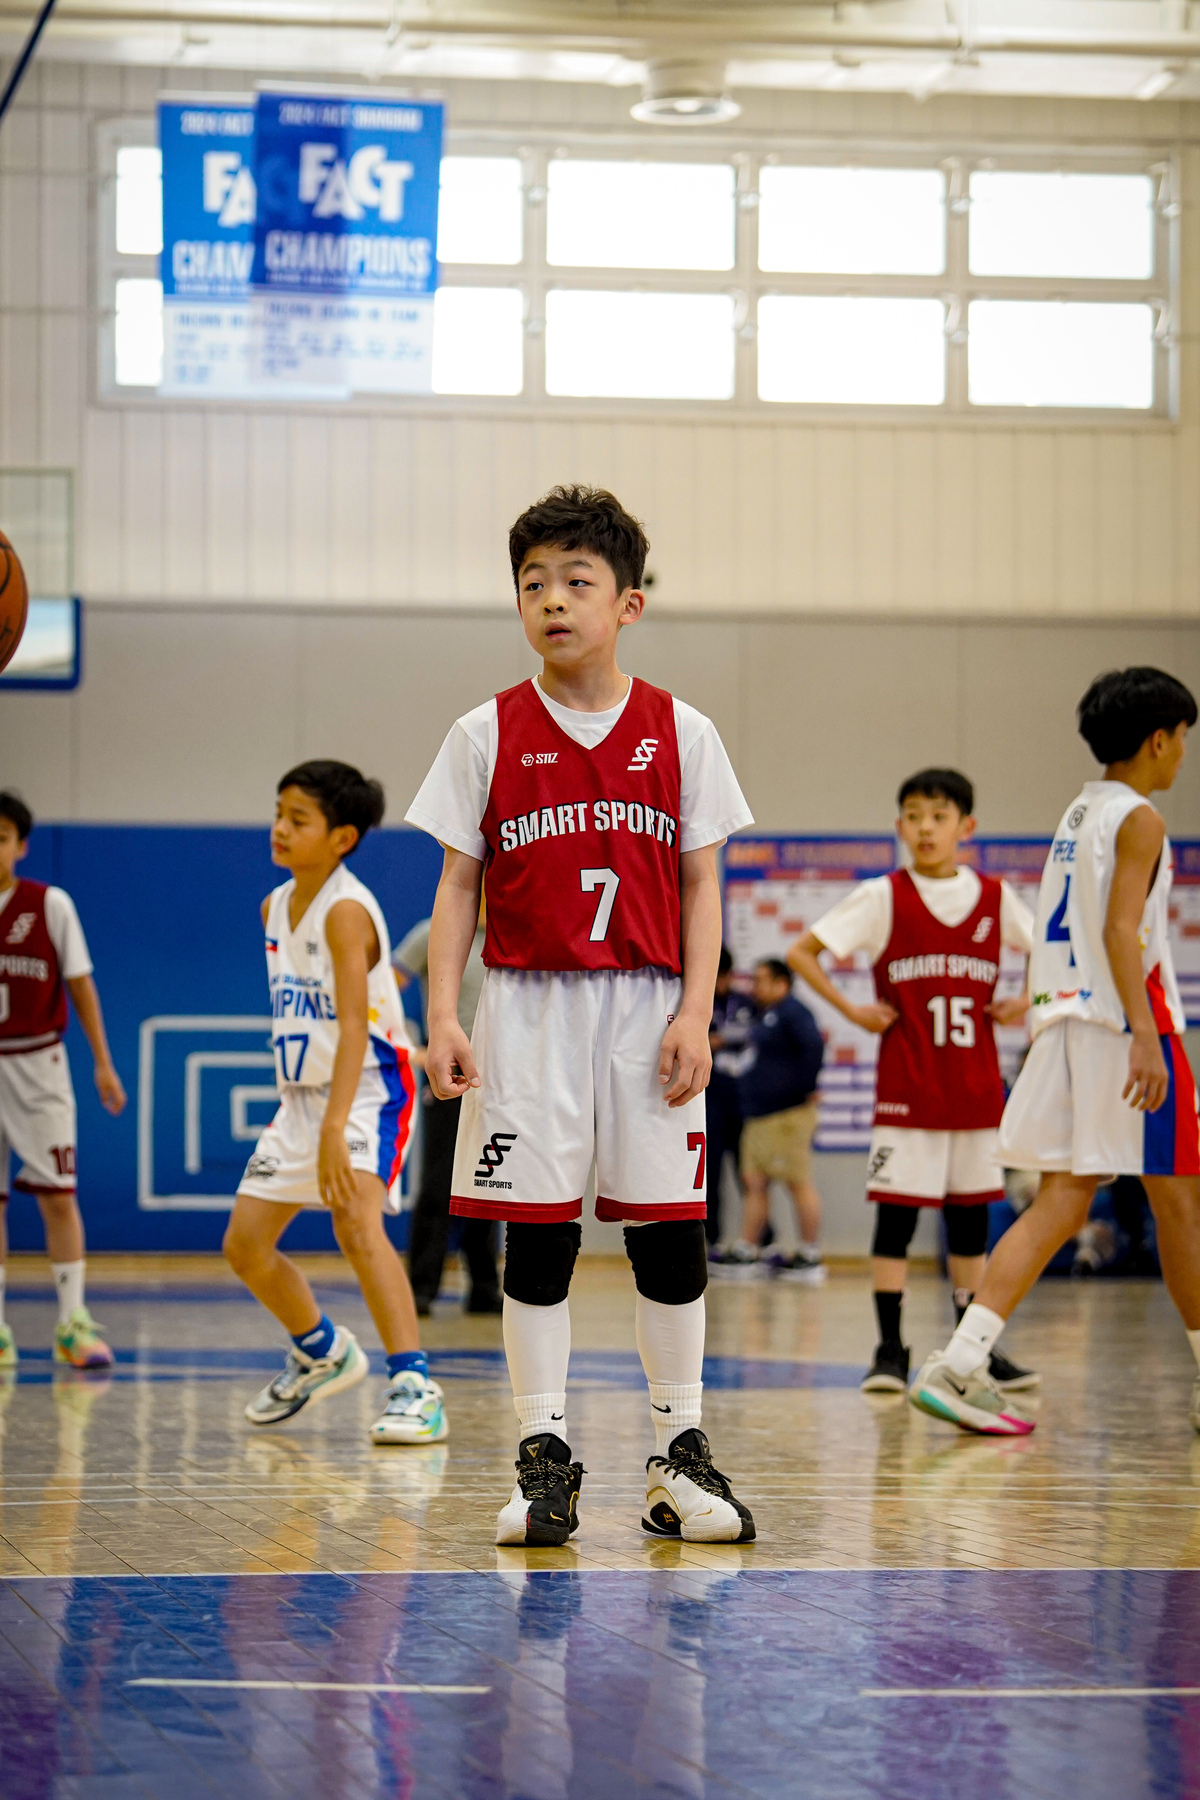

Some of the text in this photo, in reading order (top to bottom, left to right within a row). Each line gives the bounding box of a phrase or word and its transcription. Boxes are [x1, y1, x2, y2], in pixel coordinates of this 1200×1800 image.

[203, 151, 256, 228] FA
[298, 142, 414, 222] FACT
[264, 230, 431, 276] CHAMPIONS
[499, 799, 678, 852] SMART SPORTS
[579, 867, 621, 942] 7
[888, 953, 947, 984] SMART
[926, 995, 976, 1048] 15
[274, 1034, 309, 1082] 17
[488, 1180, 513, 1190] SPORTS
[686, 1131, 706, 1190] 7
